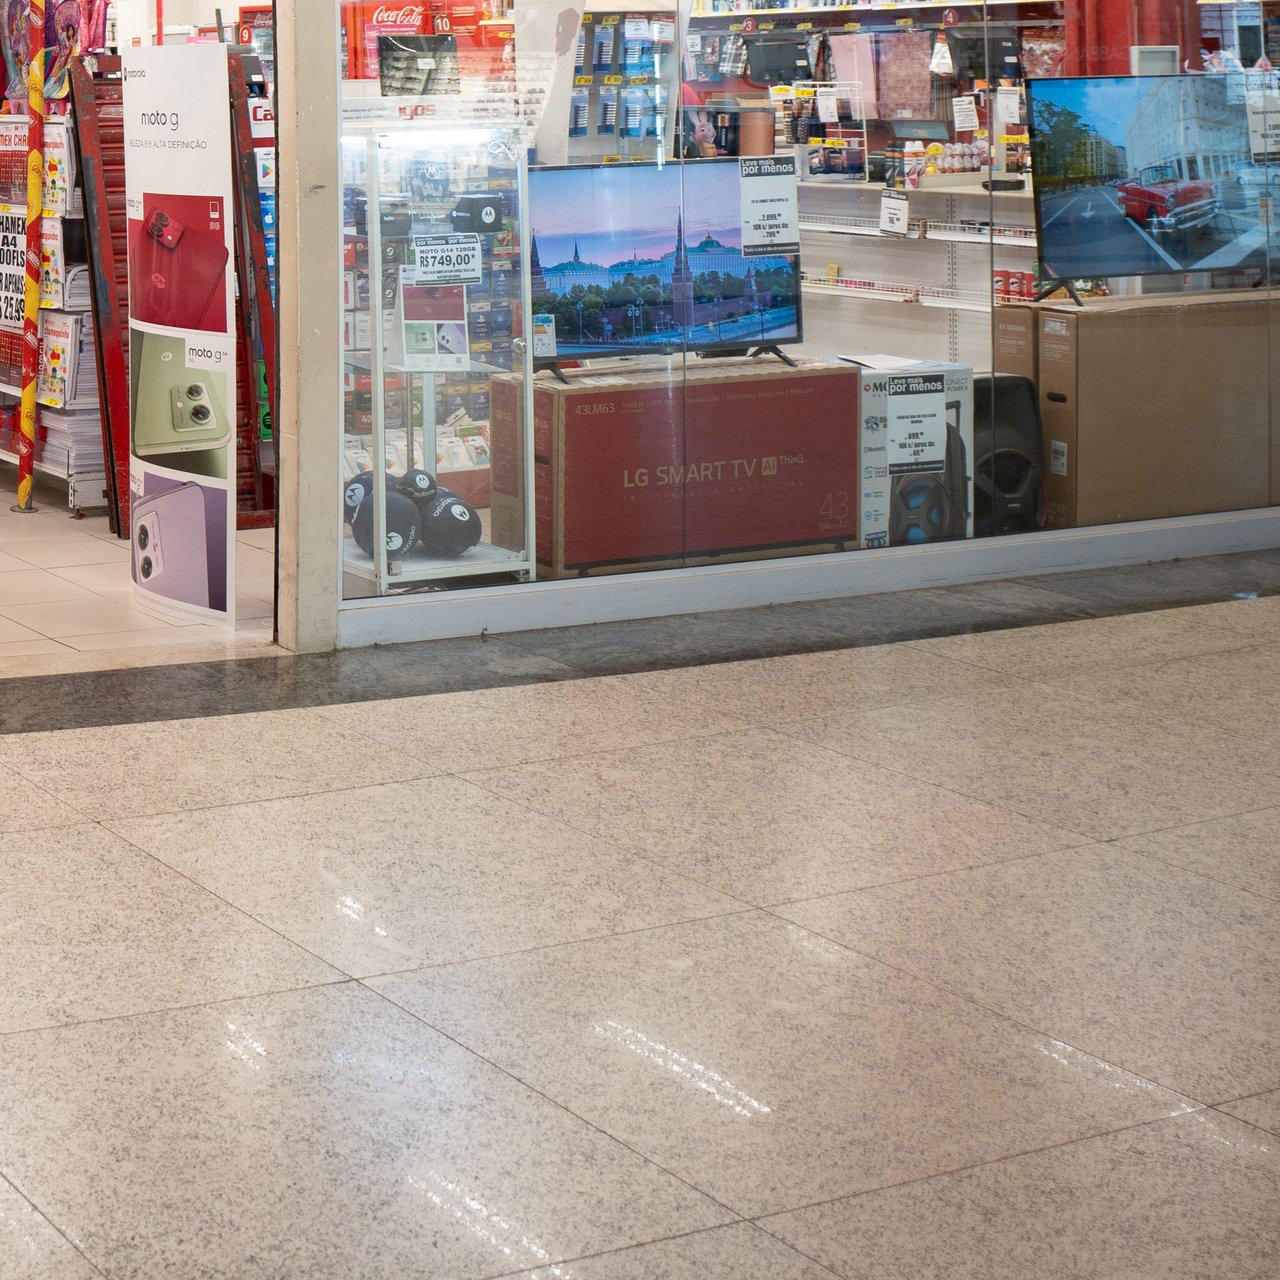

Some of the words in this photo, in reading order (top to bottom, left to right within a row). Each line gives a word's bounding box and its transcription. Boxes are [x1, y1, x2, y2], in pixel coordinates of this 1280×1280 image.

[373, 6, 425, 26] Coca-Cola
[437, 18, 450, 31] 10
[242, 29, 249, 41] 9
[141, 110, 167, 125] moto
[169, 112, 179, 131] g
[168, 139, 207, 149] DEFINIÇÃO
[742, 166, 759, 176] por
[761, 164, 793, 173] menos
[1, 235, 17, 248] A4
[189, 348, 212, 359] moto
[890, 384, 908, 394] por
[910, 382, 942, 391] menos
[575, 403, 615, 416] 43LM63
[623, 468, 648, 488] LG
[656, 461, 726, 486] SMART
[730, 458, 756, 479] TV
[778, 454, 804, 466] ThinQ
